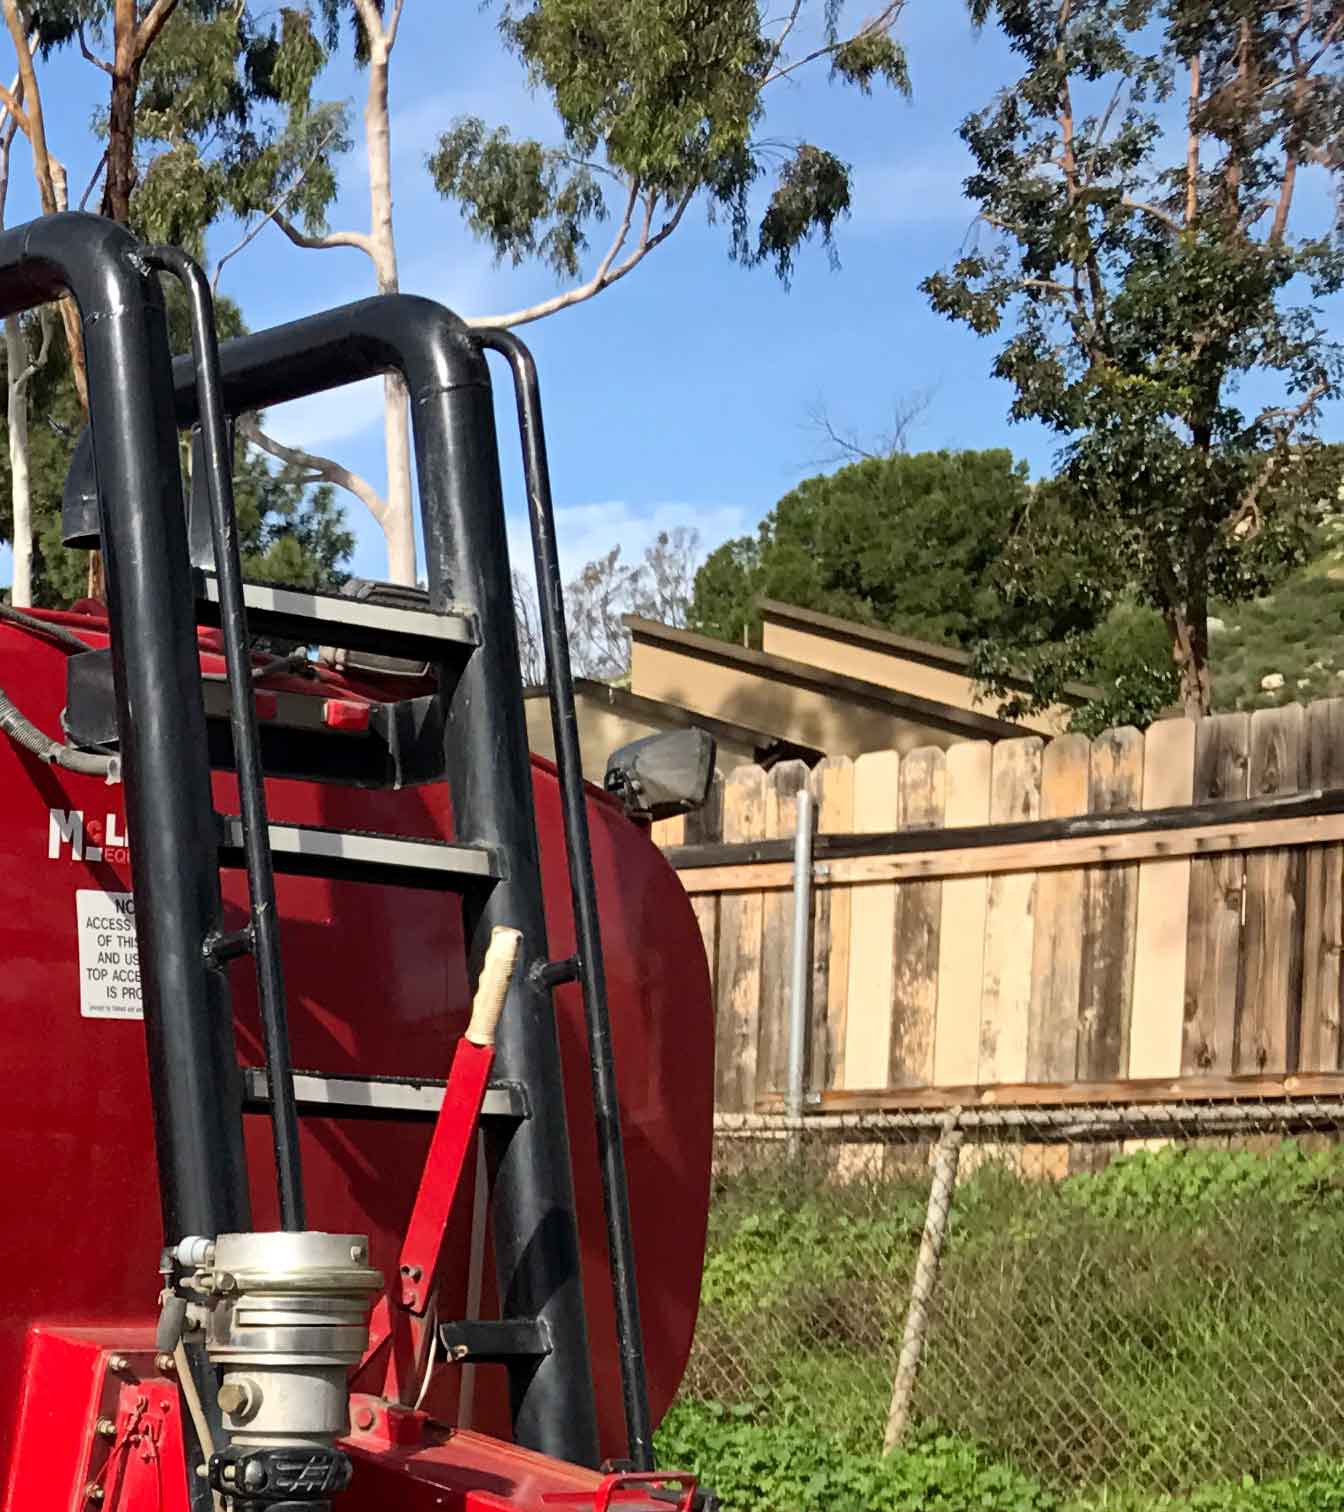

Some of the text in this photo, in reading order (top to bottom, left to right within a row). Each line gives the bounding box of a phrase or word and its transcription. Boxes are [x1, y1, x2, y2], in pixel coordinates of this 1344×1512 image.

[48, 808, 129, 861] McL
[104, 847, 130, 863] EQ
[86, 917, 132, 931] ACCESS
[97, 935, 113, 947] OF
[97, 952, 121, 964] AND
[86, 968, 108, 980] TOP
[106, 986, 117, 998] IS
